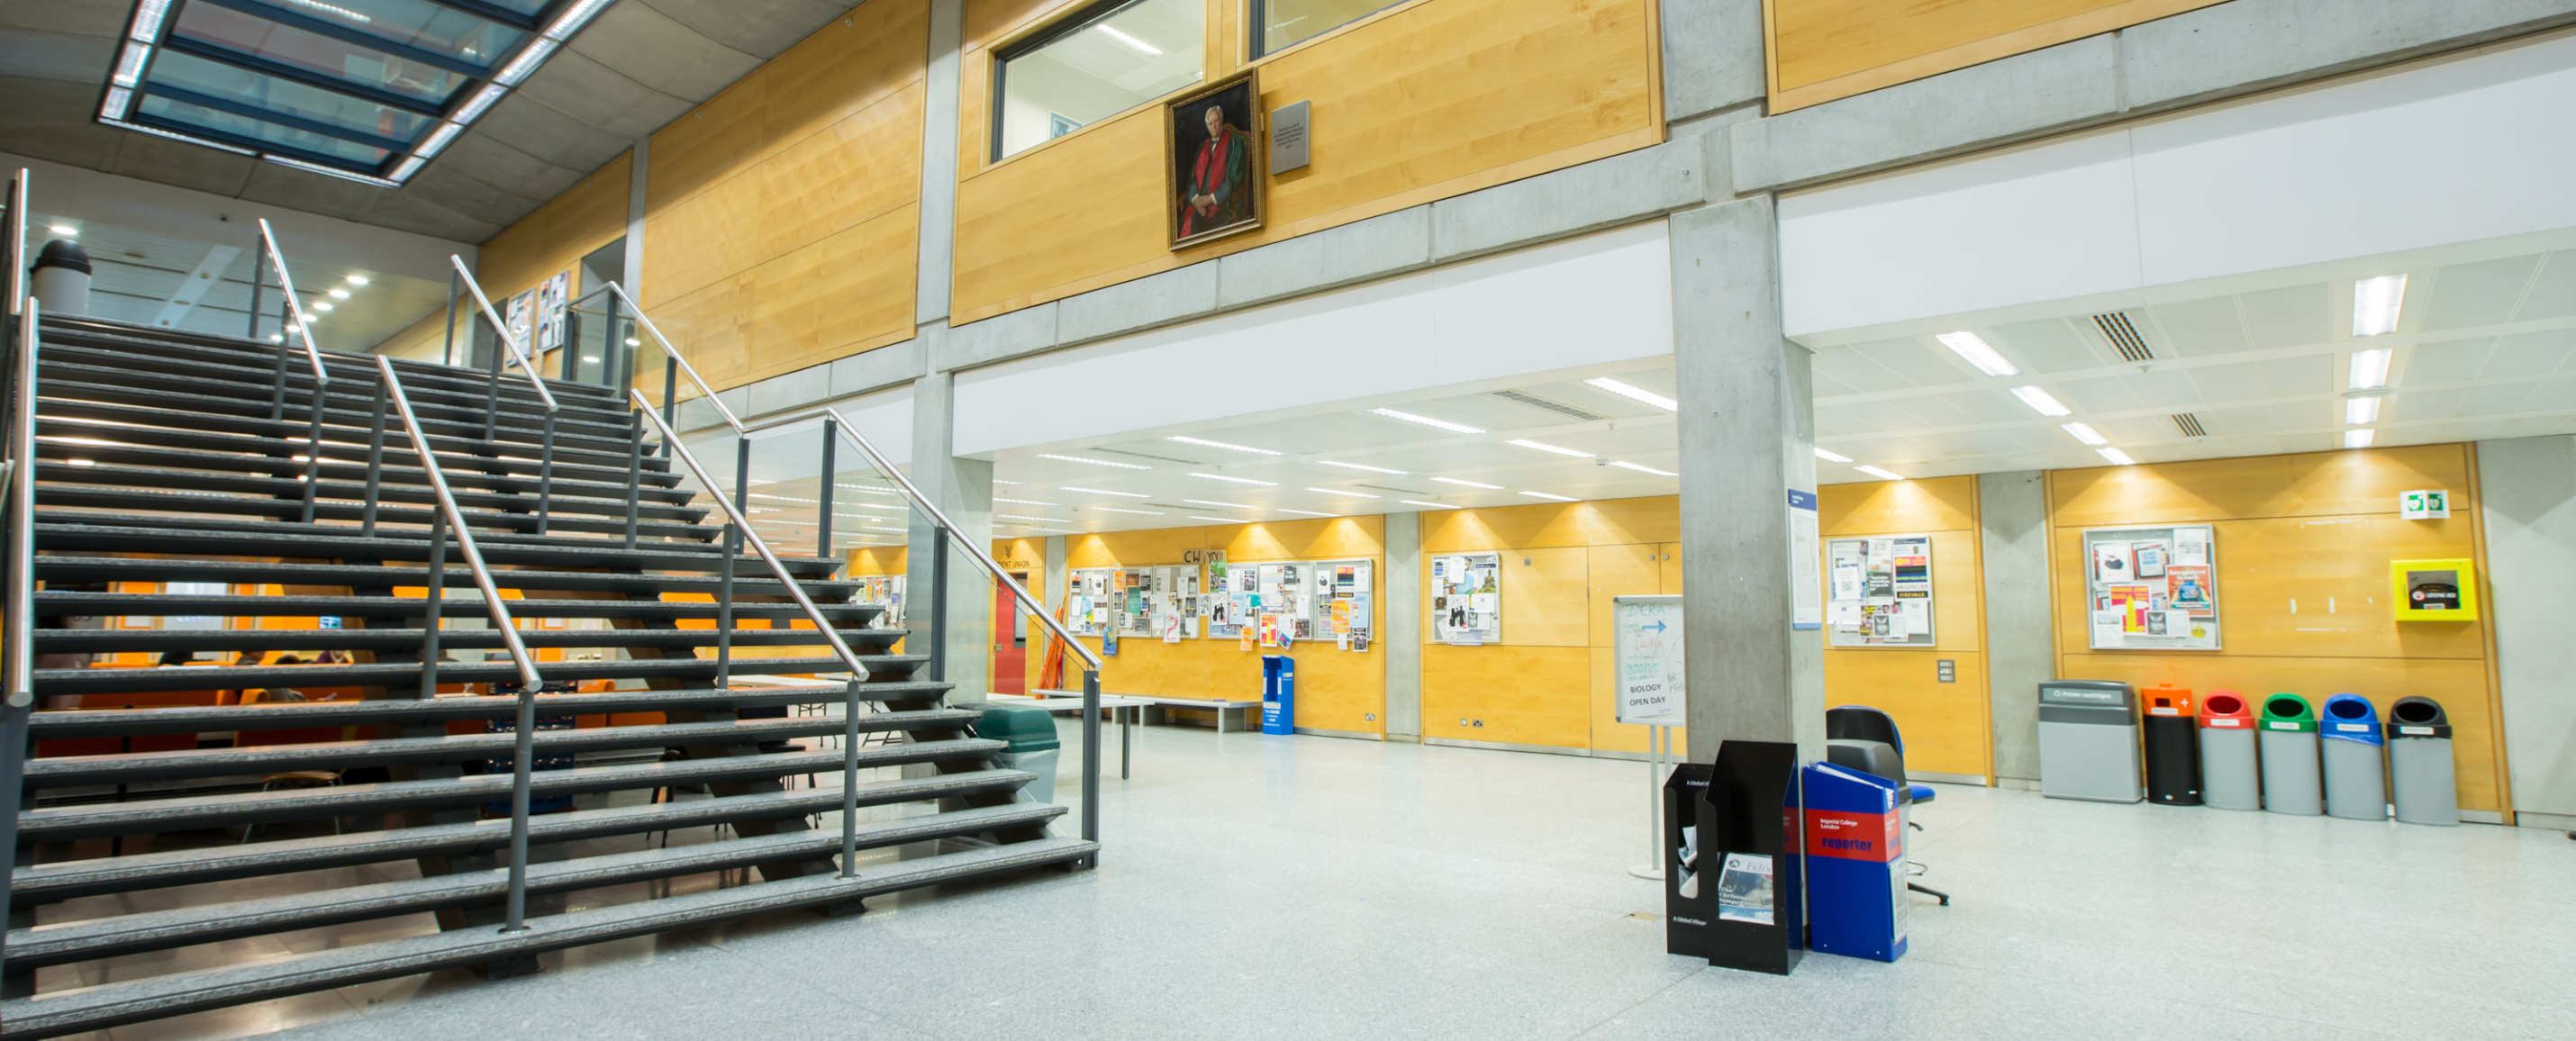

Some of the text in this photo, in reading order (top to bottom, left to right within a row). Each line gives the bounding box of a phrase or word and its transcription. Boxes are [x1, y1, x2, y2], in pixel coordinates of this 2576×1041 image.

[1630, 684, 1661, 693] BIOLOGY
[1629, 696, 1665, 707] OPEN DAY
[1822, 837, 1873, 851] reporter
